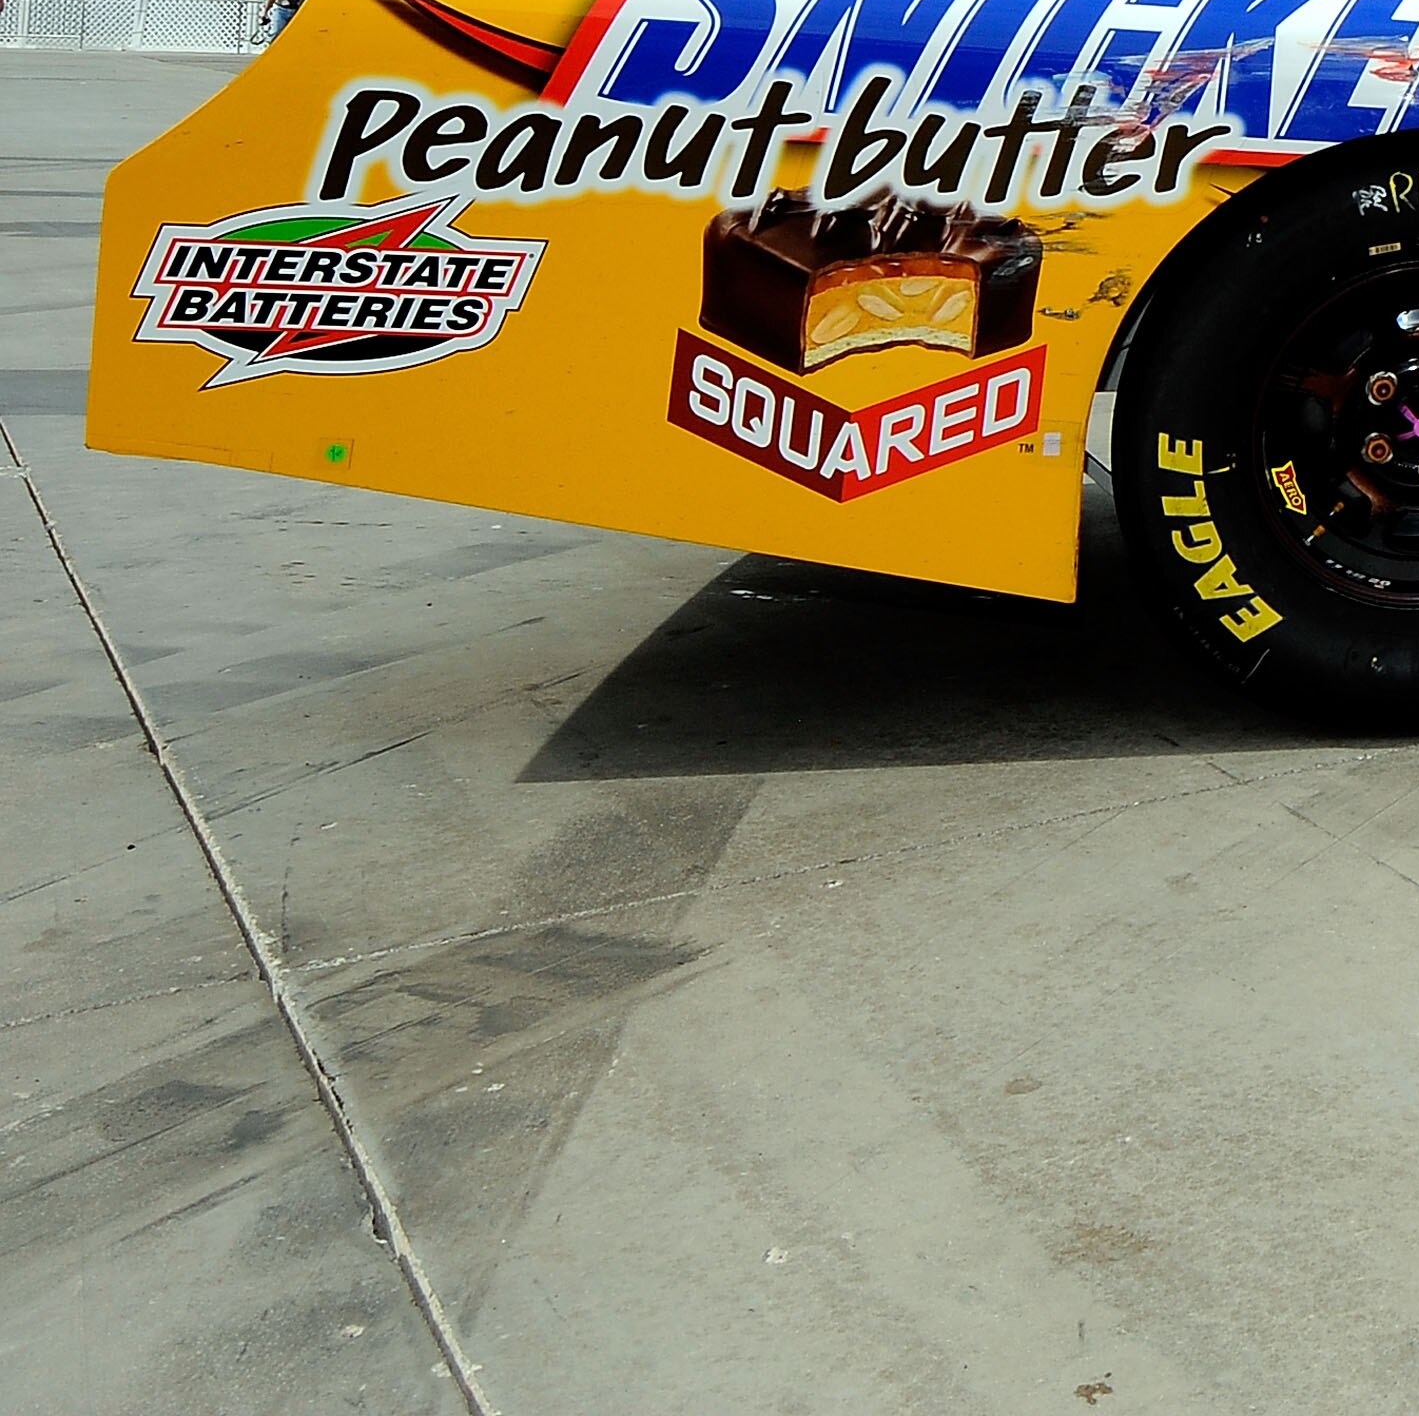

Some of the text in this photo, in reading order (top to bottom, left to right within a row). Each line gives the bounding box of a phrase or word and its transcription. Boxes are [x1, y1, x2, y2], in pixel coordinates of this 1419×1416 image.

[318, 75, 1232, 204] Peanut butter
[165, 244, 518, 291] INTERSTATE
[170, 290, 489, 332] BATTERIES
[687, 352, 1033, 482] SQUARED
[1278, 471, 1303, 507] AERO
[1157, 431, 1284, 643] EAGLE
